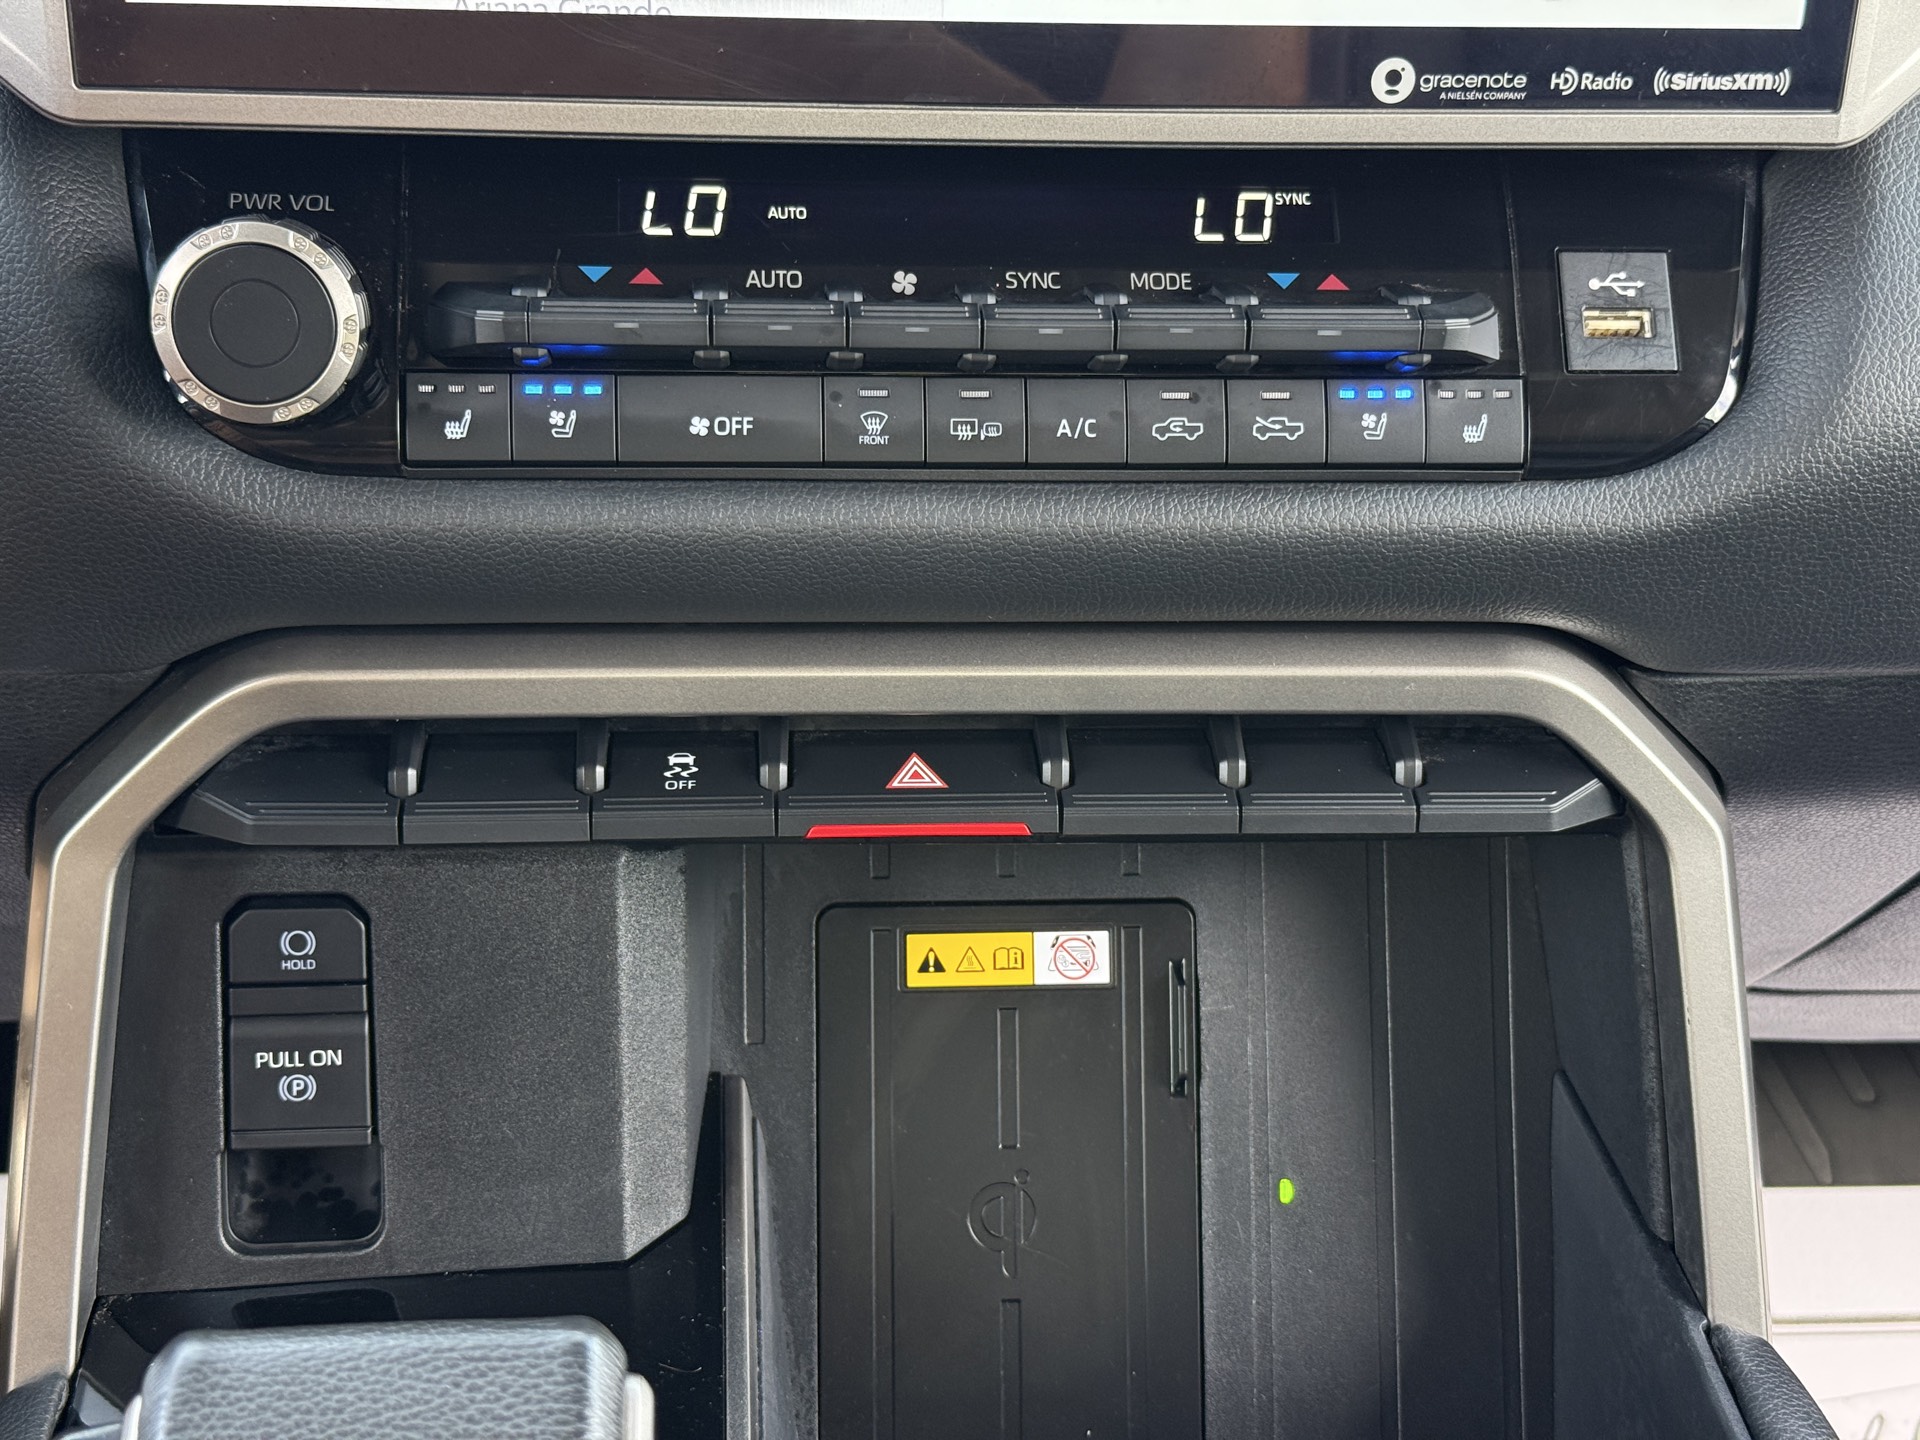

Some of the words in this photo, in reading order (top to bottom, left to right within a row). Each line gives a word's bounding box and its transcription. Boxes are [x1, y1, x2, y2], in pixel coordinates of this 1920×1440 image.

[1419, 73, 1527, 92] gracenote
[1581, 71, 1633, 90] Radio
[1439, 91, 1447, 100] A
[1483, 92, 1527, 100] COMPANY
[229, 193, 282, 211] PWR
[289, 194, 335, 212] VOL
[1274, 193, 1312, 206] SYNC
[641, 185, 727, 236] LO
[767, 206, 807, 220] AUTO
[1194, 192, 1273, 242] LO
[745, 269, 803, 289] AUTO
[1004, 271, 1062, 290] SYNC
[1130, 272, 1193, 291] MODE
[713, 416, 753, 436] OFF
[1055, 417, 1098, 439] A/C
[858, 435, 889, 446] FRONT
[664, 780, 697, 790] OFF
[281, 959, 316, 970] HOLD
[254, 1051, 305, 1069] PULL
[309, 1049, 343, 1067] ON
